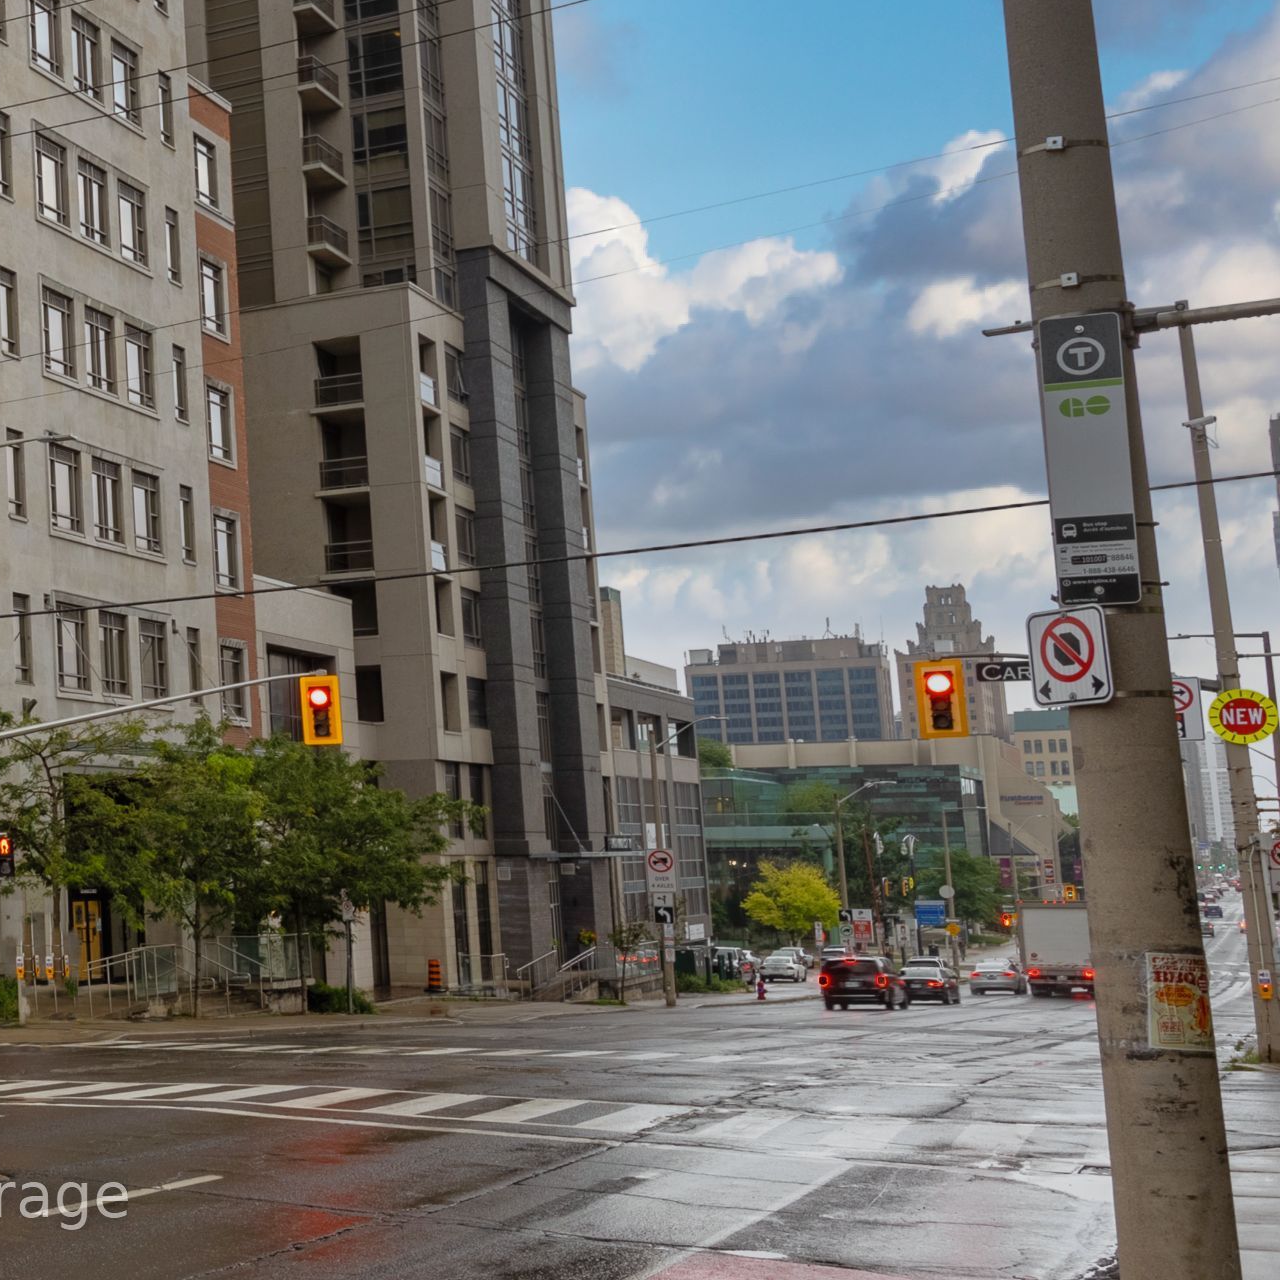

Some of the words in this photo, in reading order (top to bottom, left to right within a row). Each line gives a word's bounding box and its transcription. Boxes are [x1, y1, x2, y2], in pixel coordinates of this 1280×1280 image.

[1068, 346, 1092, 367] T
[982, 664, 1031, 680] CAR
[1222, 708, 1262, 725] NEW
